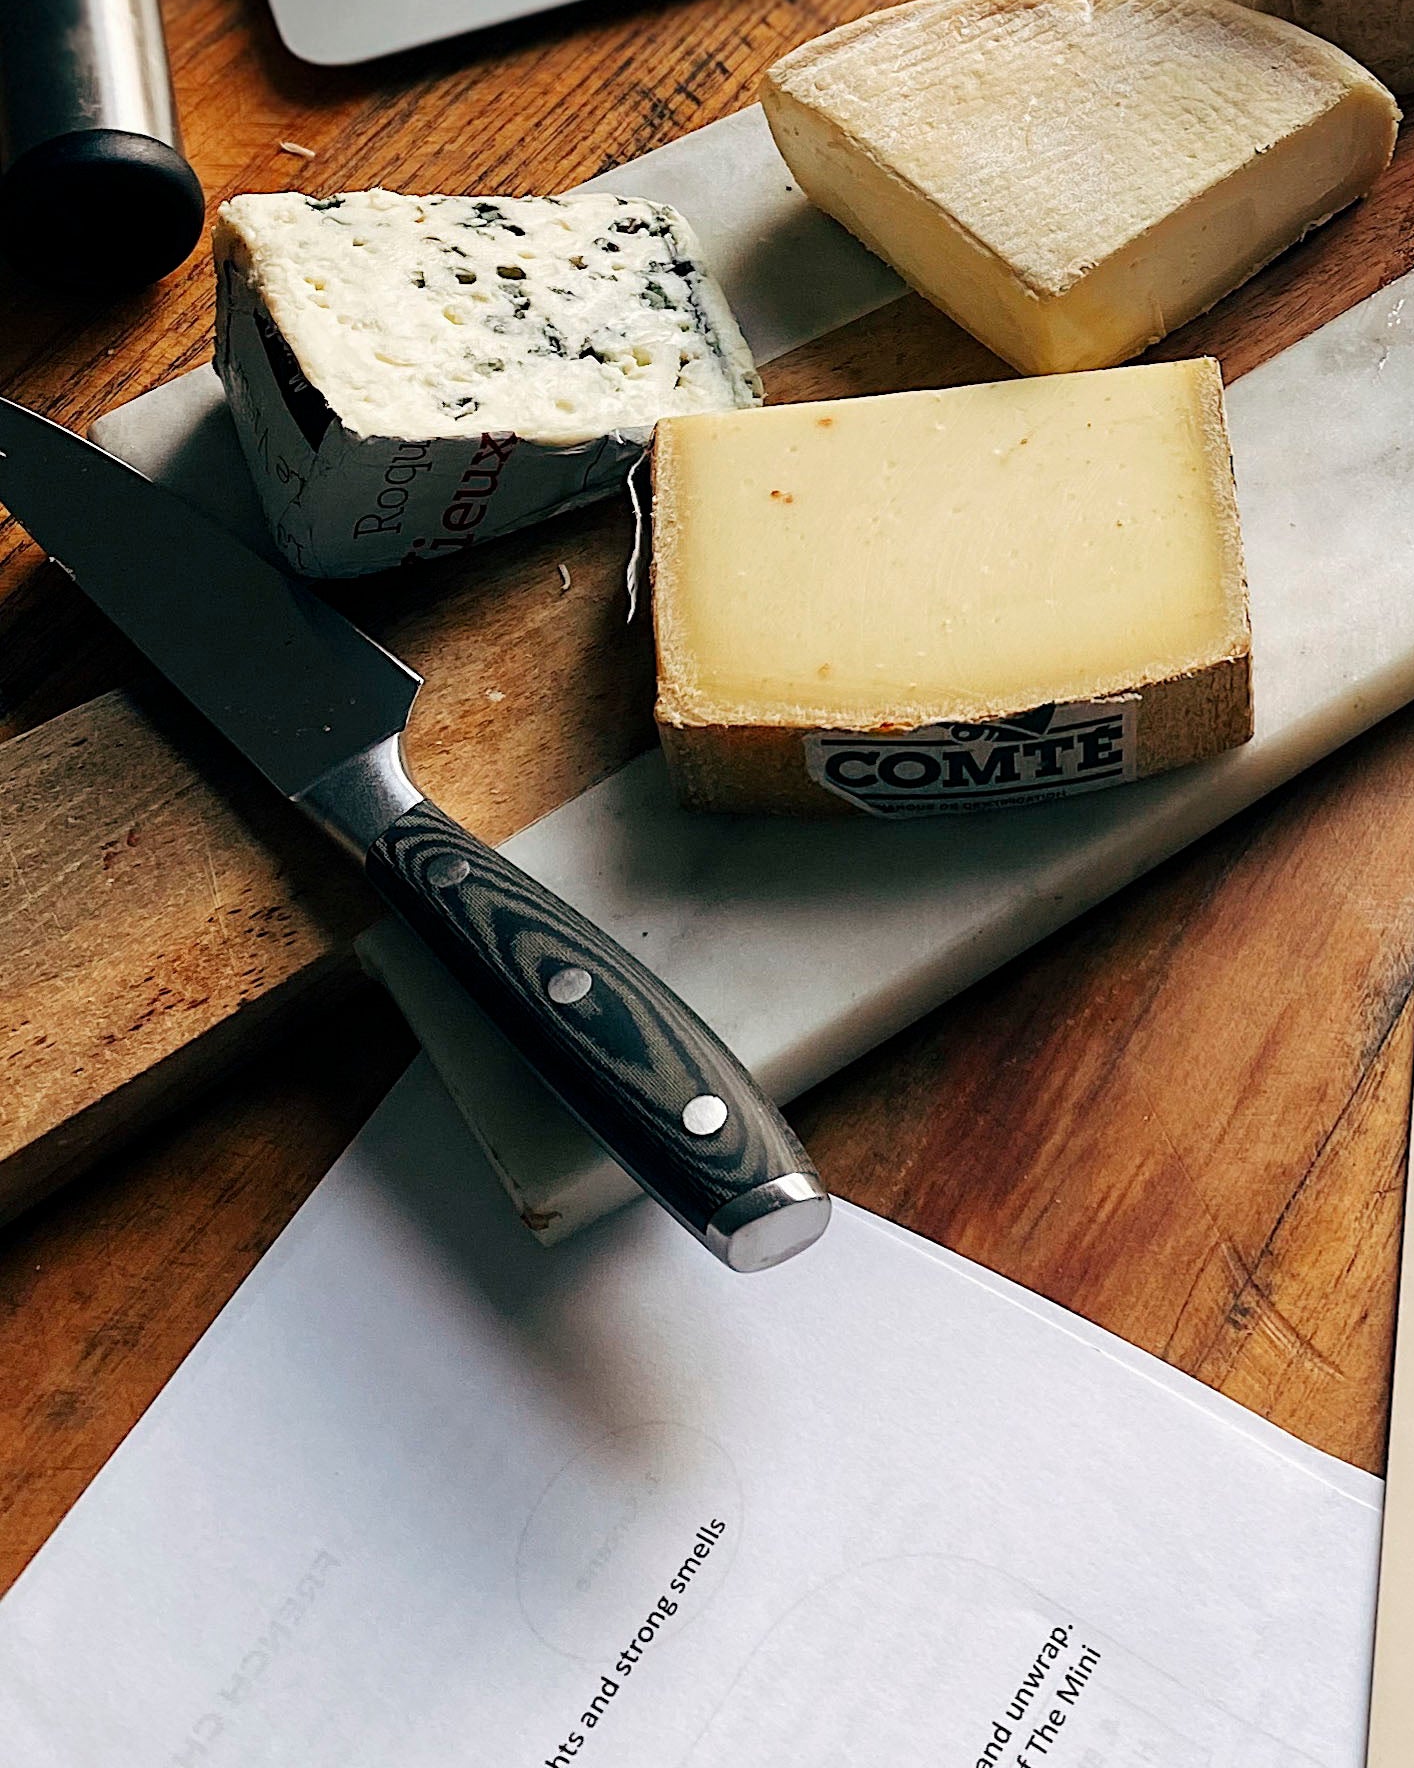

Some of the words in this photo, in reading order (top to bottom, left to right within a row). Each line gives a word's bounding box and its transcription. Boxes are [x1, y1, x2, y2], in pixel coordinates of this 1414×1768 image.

[353, 439, 432, 540] Roqu
[402, 432, 522, 562] ieux
[825, 724, 1123, 789] COMTÉ
[581, 1676, 620, 1729] and
[616, 1595, 679, 1676] strong
[670, 1518, 727, 1594] smells
[975, 1721, 1013, 1768] and
[1006, 1624, 1074, 1721] unwrap.
[1025, 1709, 1067, 1755] The
[1056, 1644, 1102, 1706] Mini
